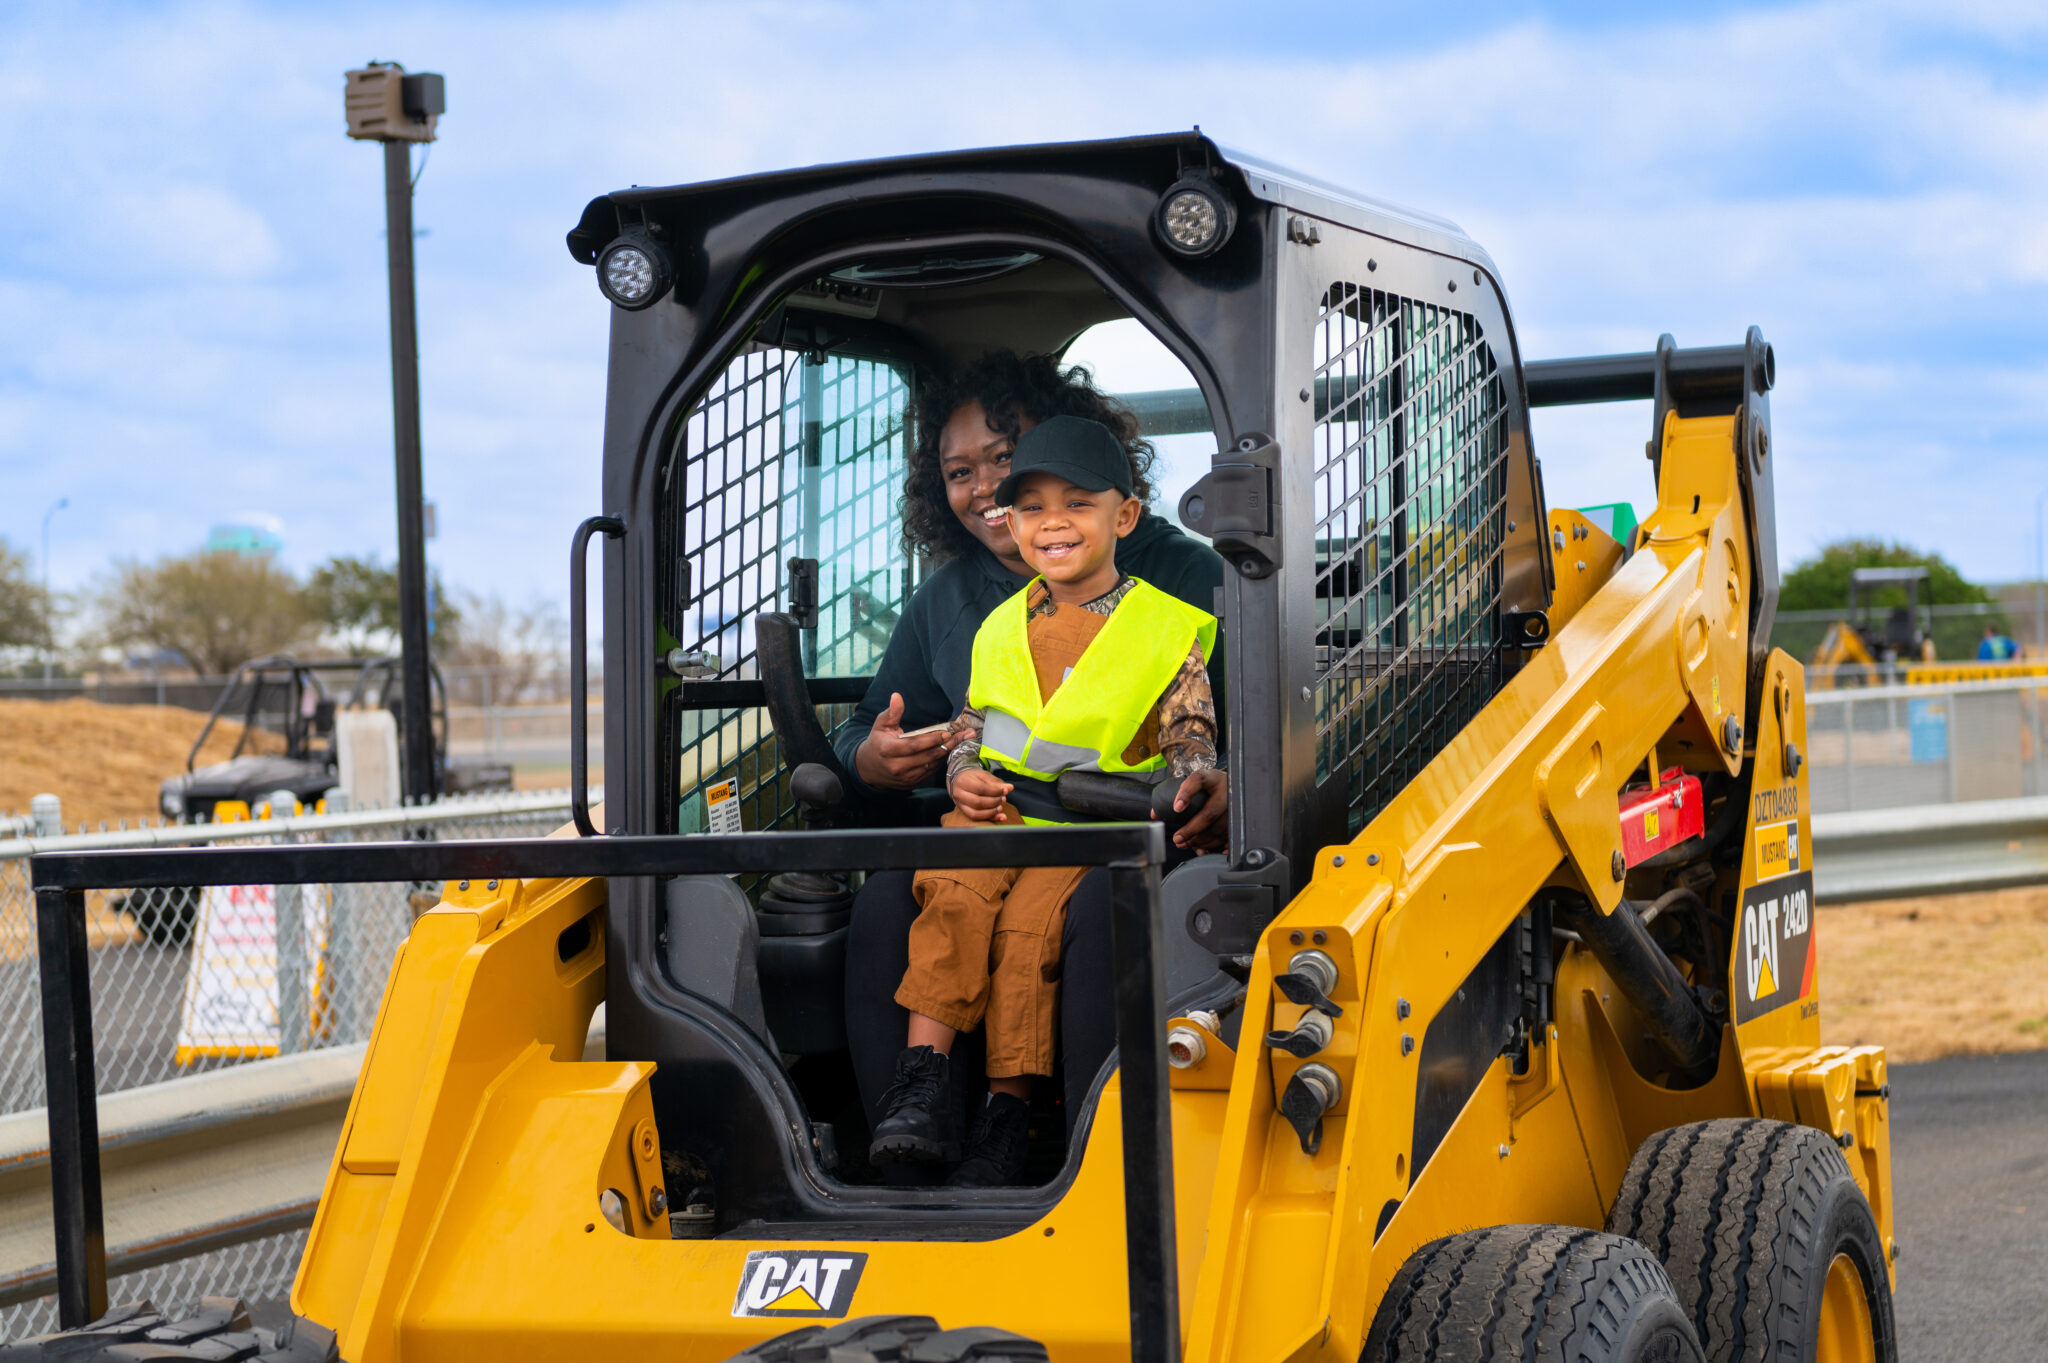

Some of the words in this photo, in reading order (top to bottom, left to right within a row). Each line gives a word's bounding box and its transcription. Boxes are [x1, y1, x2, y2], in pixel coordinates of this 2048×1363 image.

[1755, 786, 1798, 823] DZT04888
[1761, 840, 1787, 864] MUSTANG
[1788, 834, 1798, 860] CAT
[1745, 898, 1780, 1002] CAT
[1783, 889, 1808, 940] 242D
[746, 1256, 854, 1311] CAT
